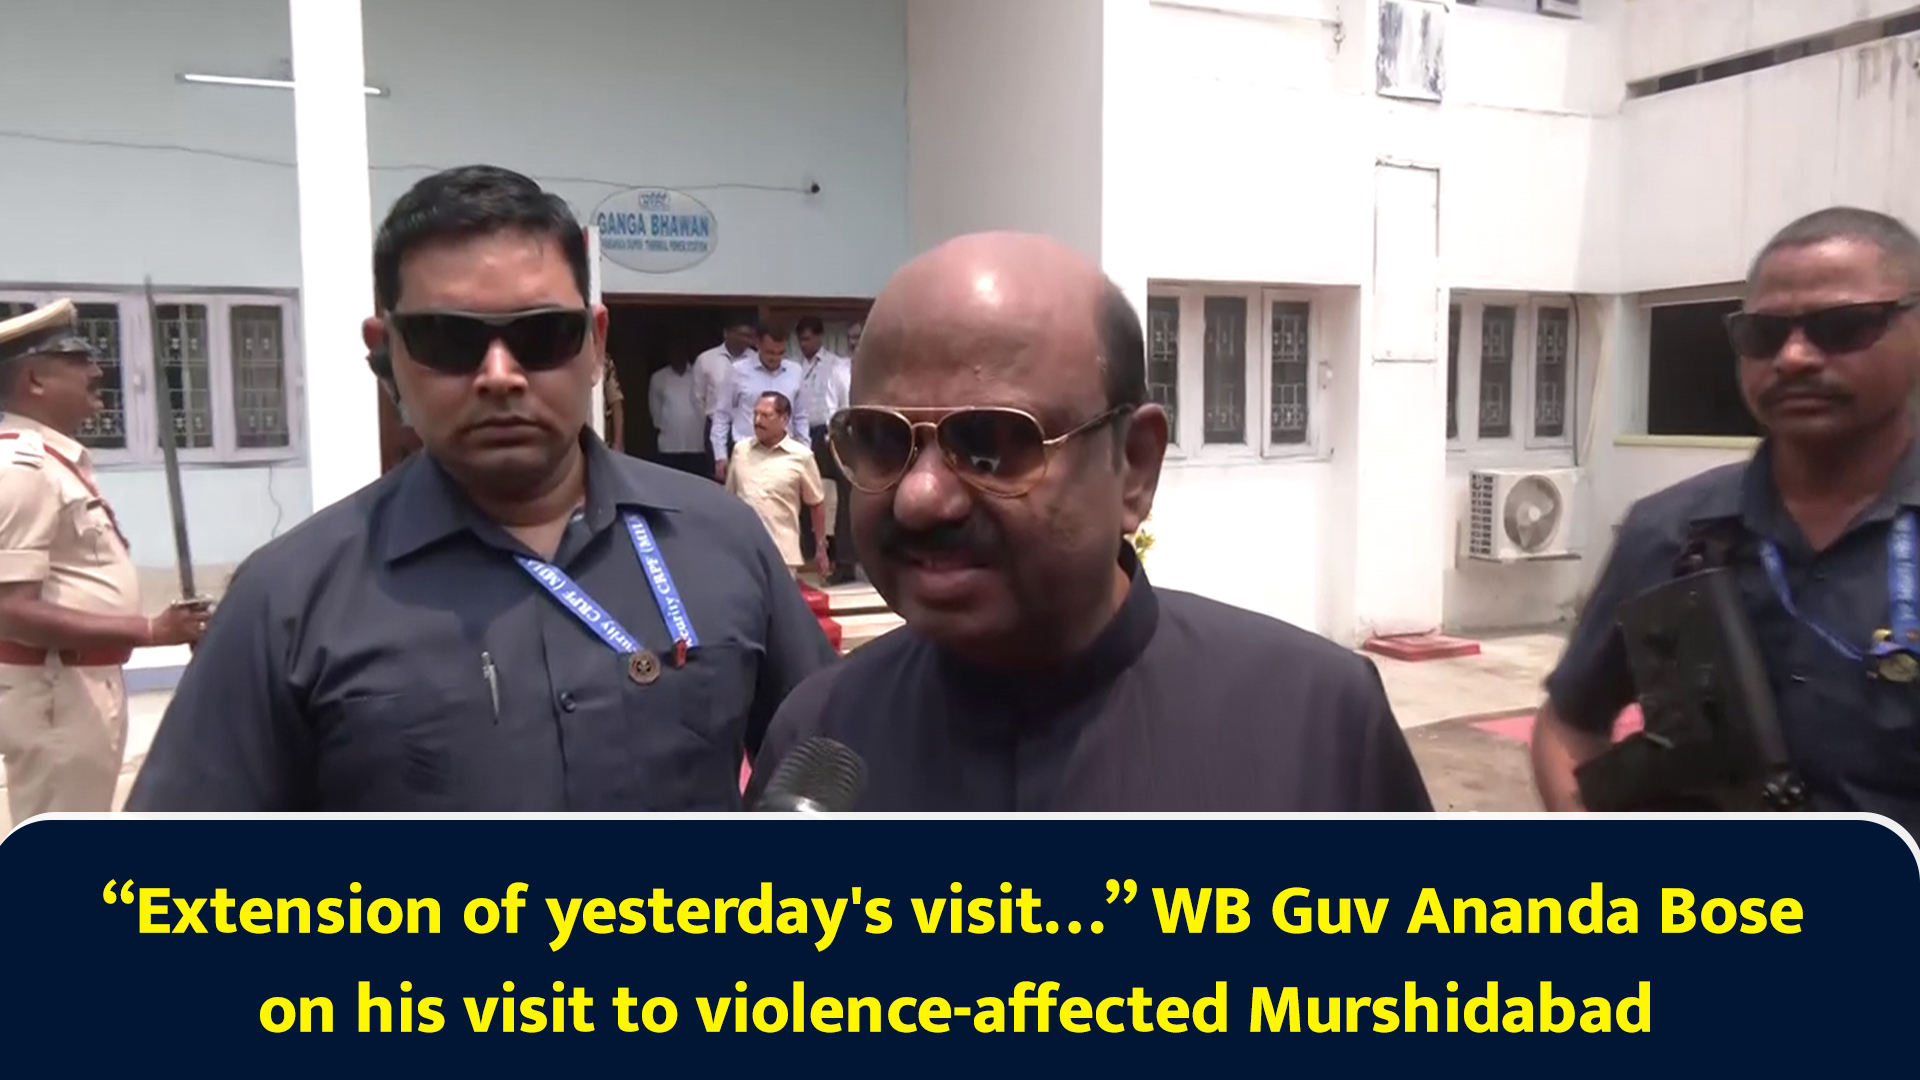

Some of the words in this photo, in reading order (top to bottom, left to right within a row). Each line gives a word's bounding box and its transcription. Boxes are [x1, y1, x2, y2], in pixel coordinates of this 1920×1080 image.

[598, 212, 646, 235] GANGA
[651, 214, 708, 237] BHAWAN
[645, 557, 671, 594] CRPF
